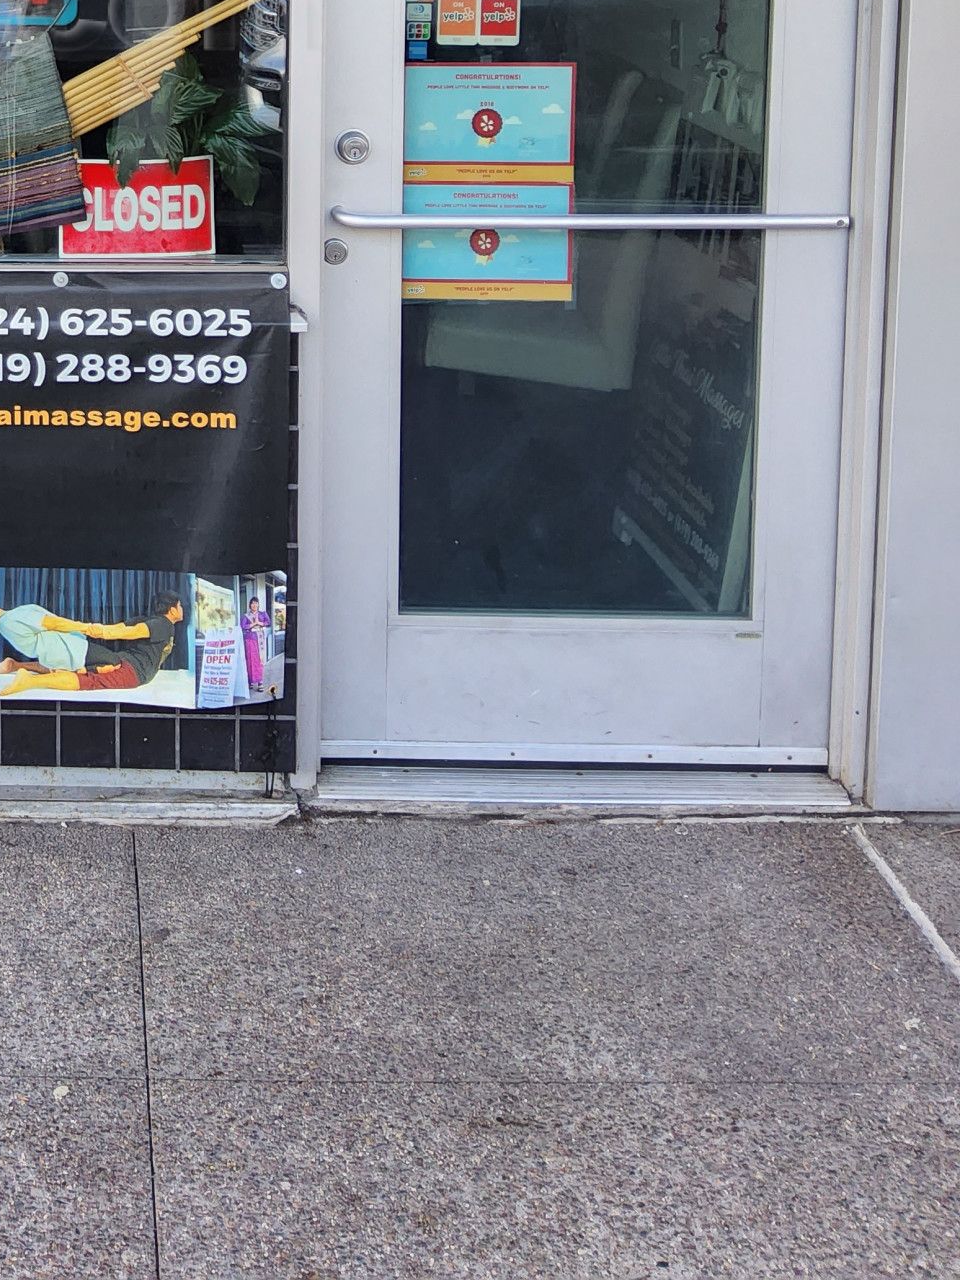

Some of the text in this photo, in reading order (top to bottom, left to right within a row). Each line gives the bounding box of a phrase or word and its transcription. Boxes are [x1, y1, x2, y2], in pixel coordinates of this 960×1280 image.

[443, 11, 464, 22] yelp
[484, 11, 505, 22] yelp
[71, 184, 206, 233] CLOSED
[59, 308, 253, 338] 625-6025
[55, 352, 248, 384] 288-9369
[206, 655, 231, 664] OPEN
